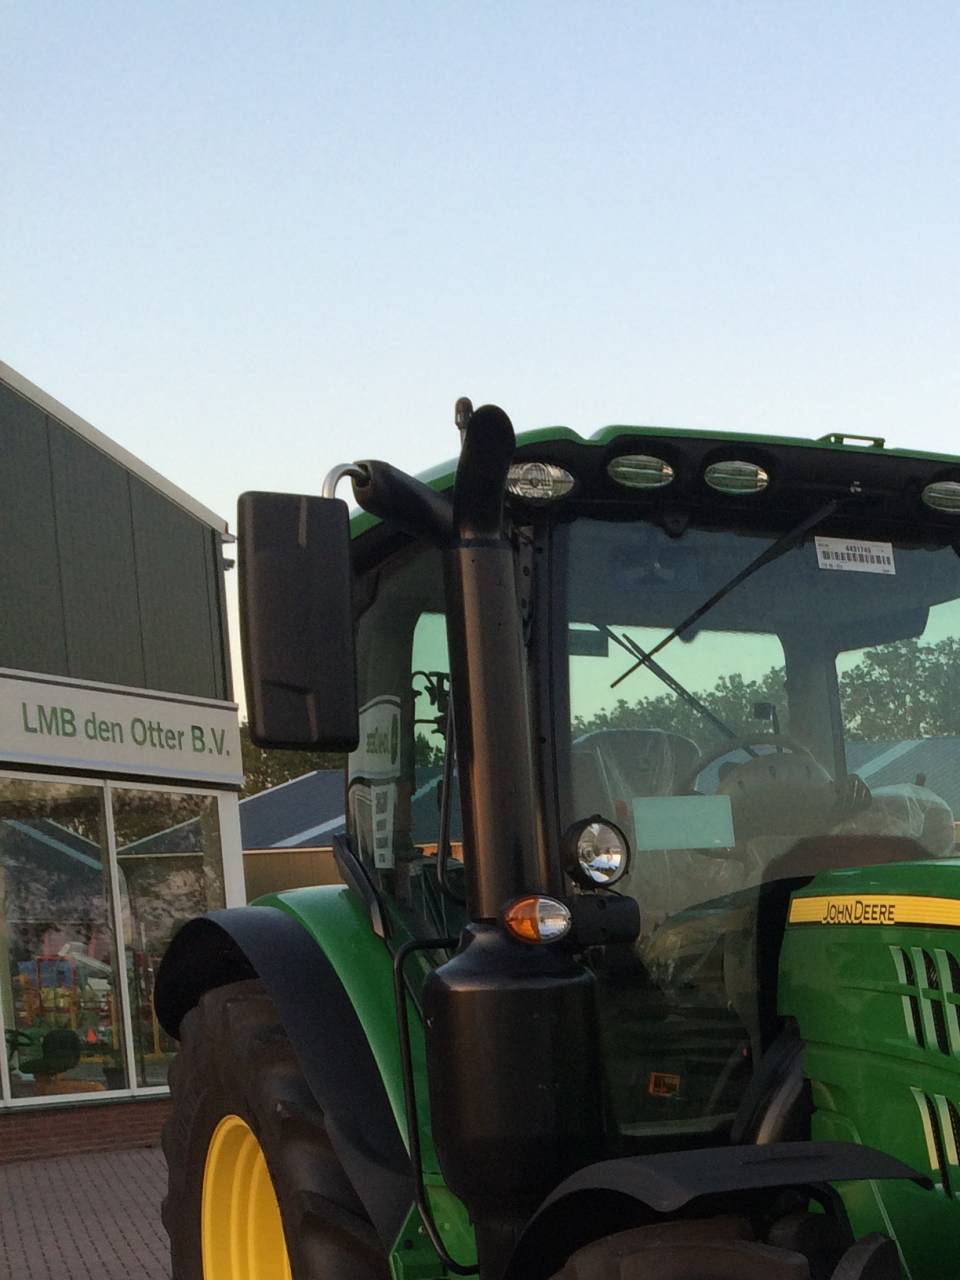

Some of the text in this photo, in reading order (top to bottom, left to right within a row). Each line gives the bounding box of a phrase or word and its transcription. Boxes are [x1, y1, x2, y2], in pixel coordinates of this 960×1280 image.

[21, 702, 230, 756] LMB den Otter B.V.
